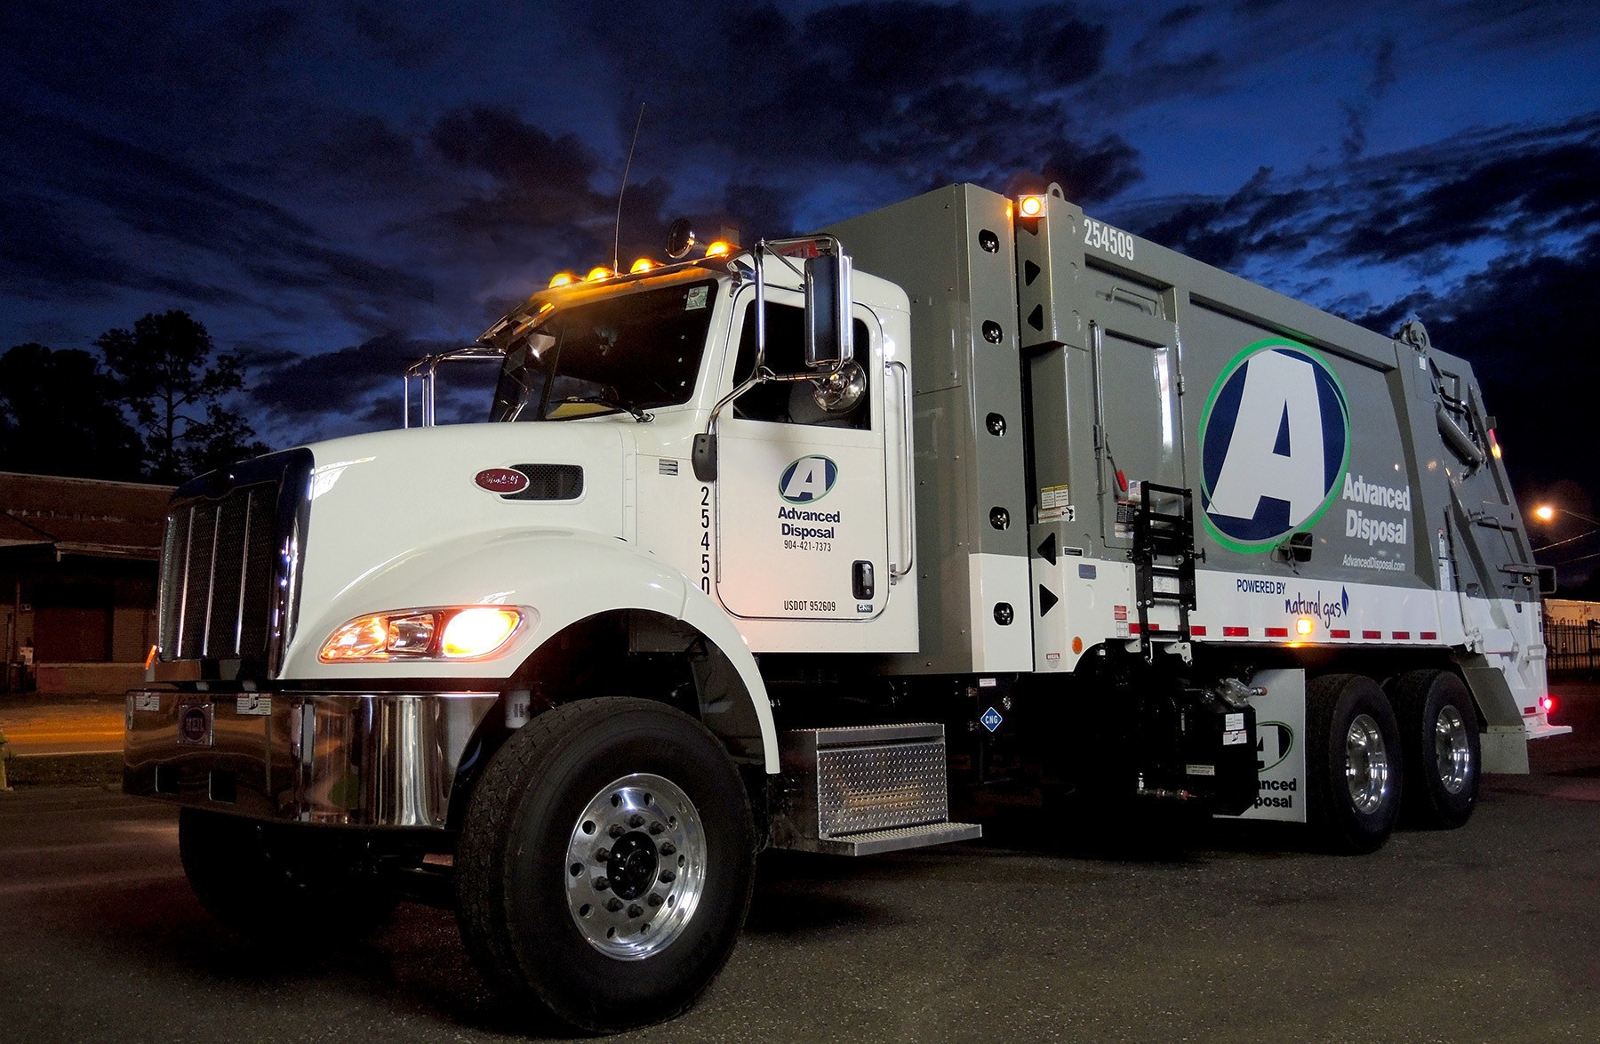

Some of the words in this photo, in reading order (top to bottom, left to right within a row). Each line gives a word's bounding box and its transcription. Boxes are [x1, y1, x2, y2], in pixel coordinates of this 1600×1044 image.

[1083, 218, 1134, 261] 254509
[1206, 349, 1326, 527] A
[783, 457, 827, 499] A
[1342, 472, 1411, 512] Advanced
[778, 507, 841, 523] Advanced
[781, 524, 835, 540] Disposal
[1345, 508, 1407, 546] Disposal
[784, 540, 832, 552] 904-421-7373
[1342, 554, 1406, 572] AdvancedDisposal.com
[1236, 579, 1275, 594] POWERED
[1276, 582, 1286, 595] BY
[784, 600, 808, 611] USDOT
[809, 601, 836, 612] 952609
[1285, 590, 1321, 620] natural
[1323, 602, 1342, 629] gas
[985, 715, 998, 724] CNG
